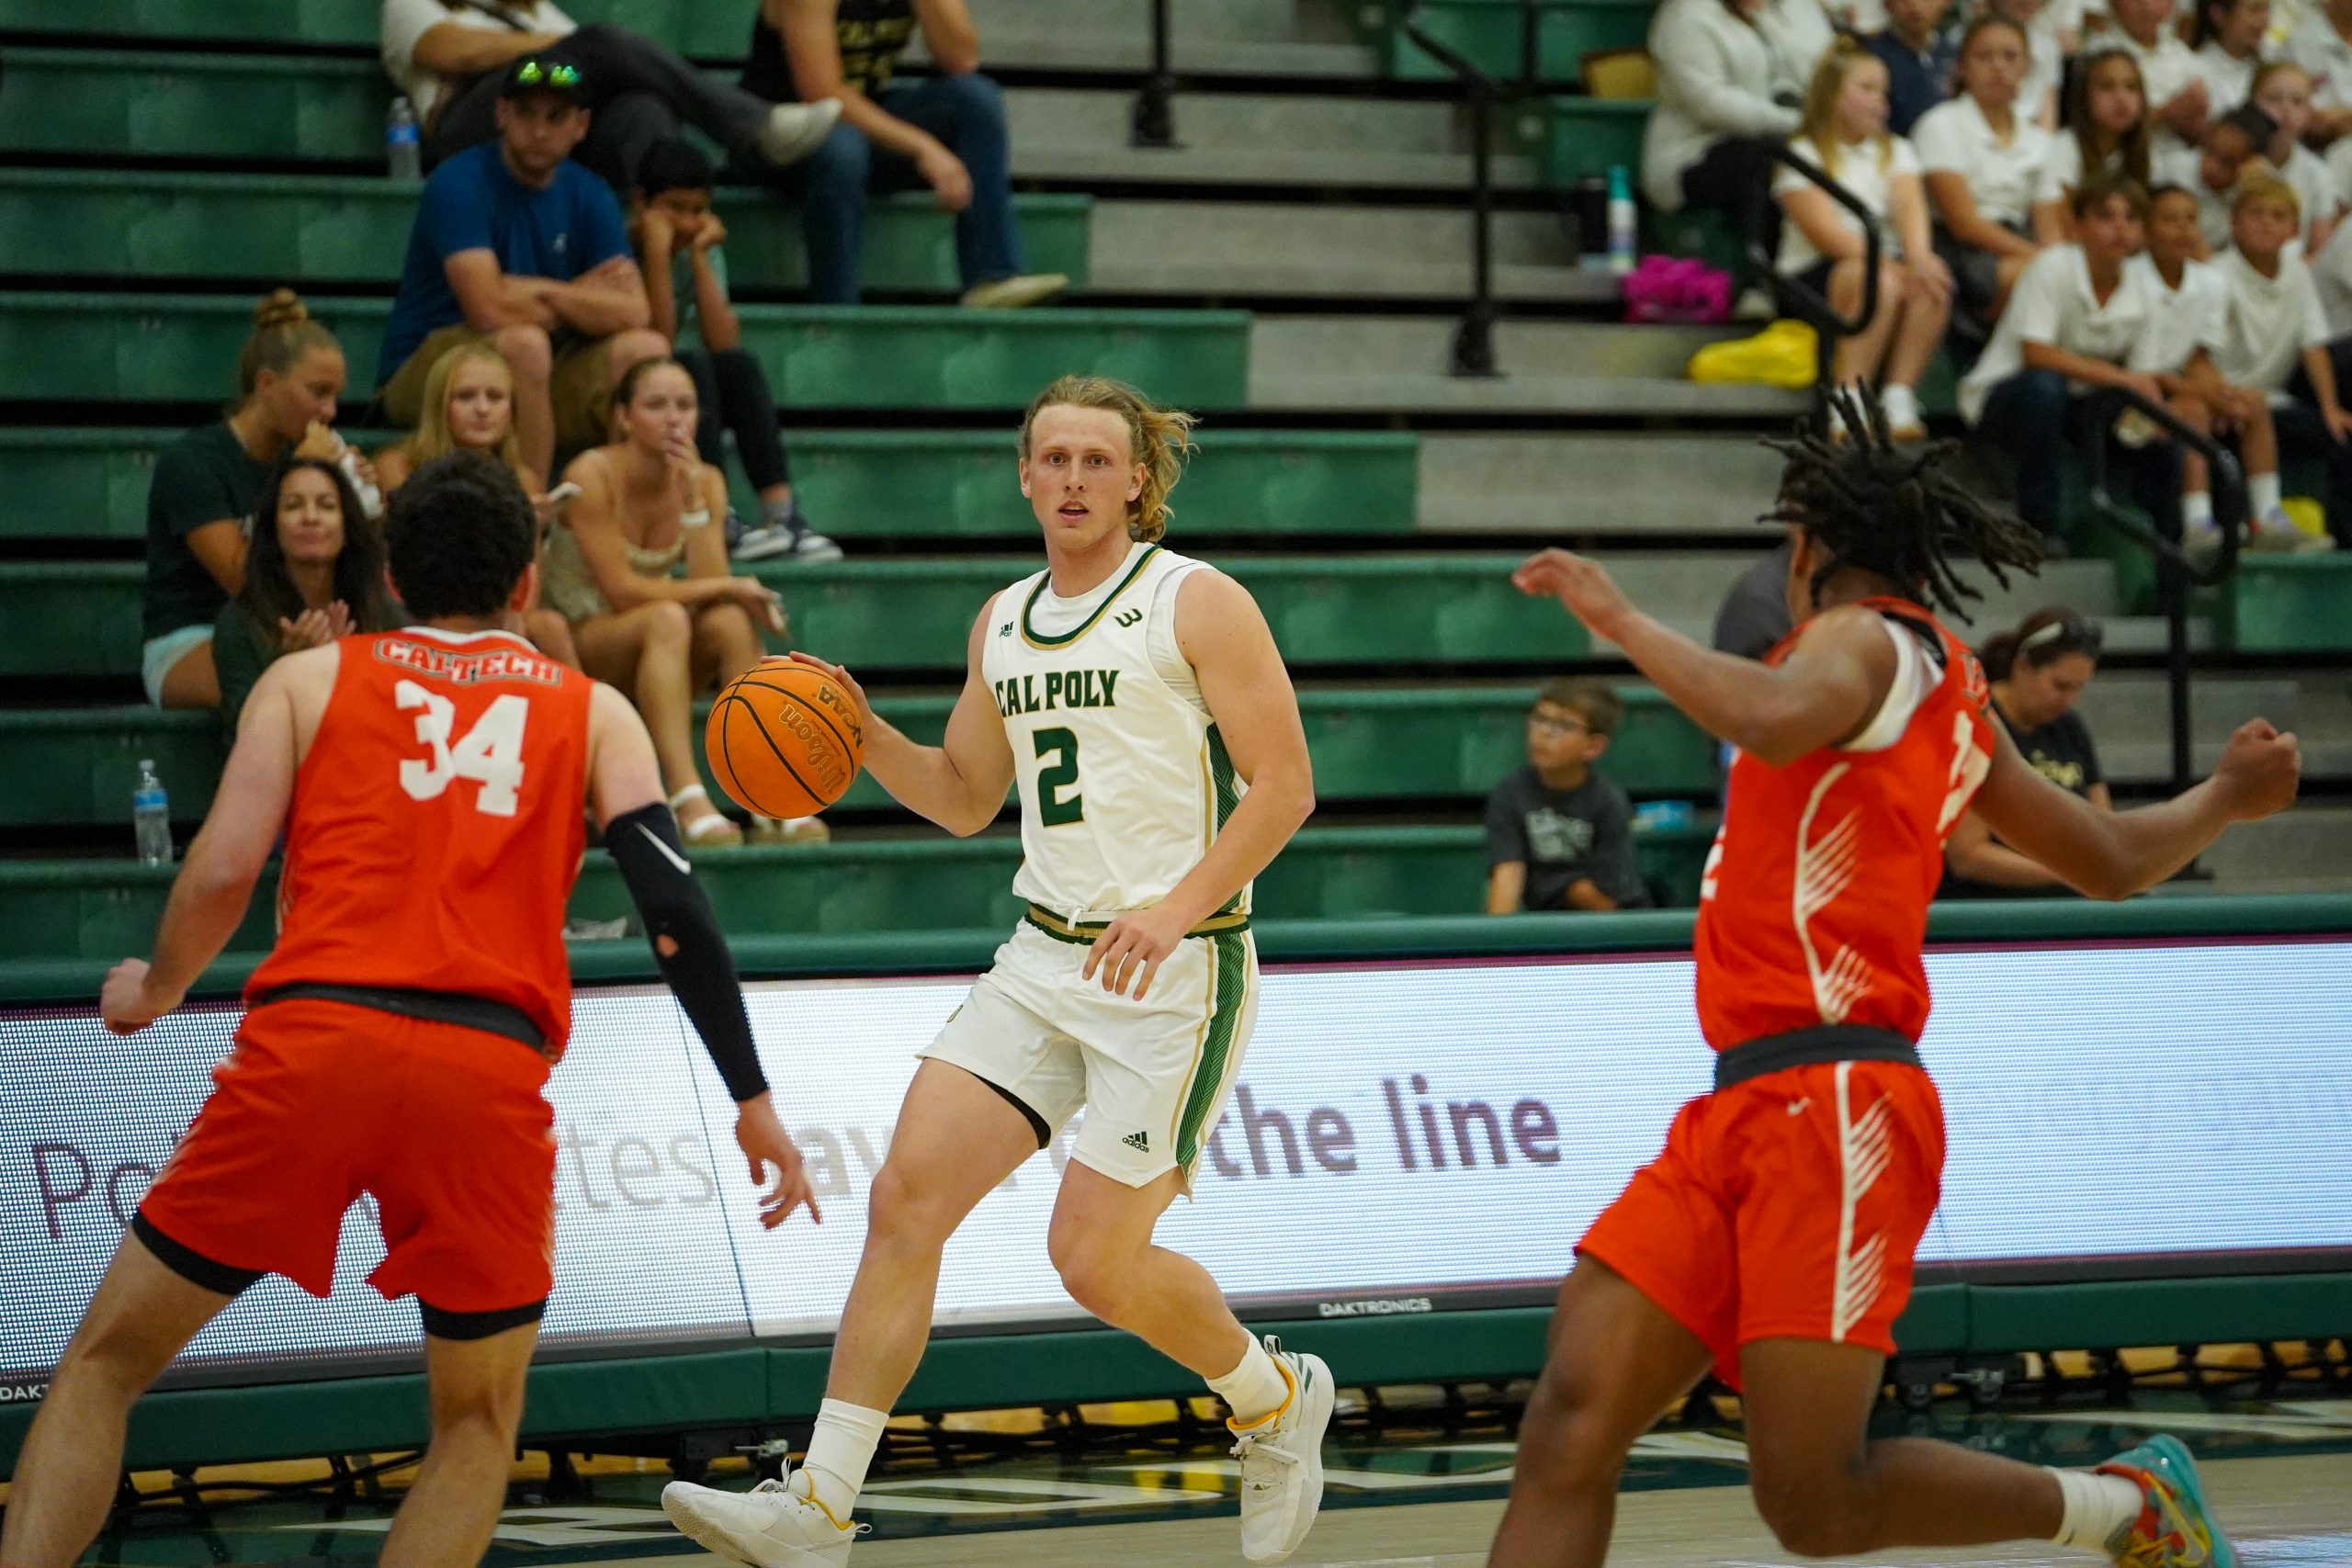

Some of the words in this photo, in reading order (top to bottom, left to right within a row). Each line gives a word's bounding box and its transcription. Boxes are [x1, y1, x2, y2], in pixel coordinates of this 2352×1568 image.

[376, 639, 561, 683] CALTECH
[995, 673, 1041, 718] CAL
[1045, 669, 1122, 709] POLY
[394, 679, 529, 818] 34
[778, 704, 847, 795] Wilson
[1032, 726, 1086, 829] 2
[1122, 1136, 1150, 1154] adidas
[1381, 1073, 1563, 1173] line
[1318, 1297, 1433, 1318] DAKTRONICS
